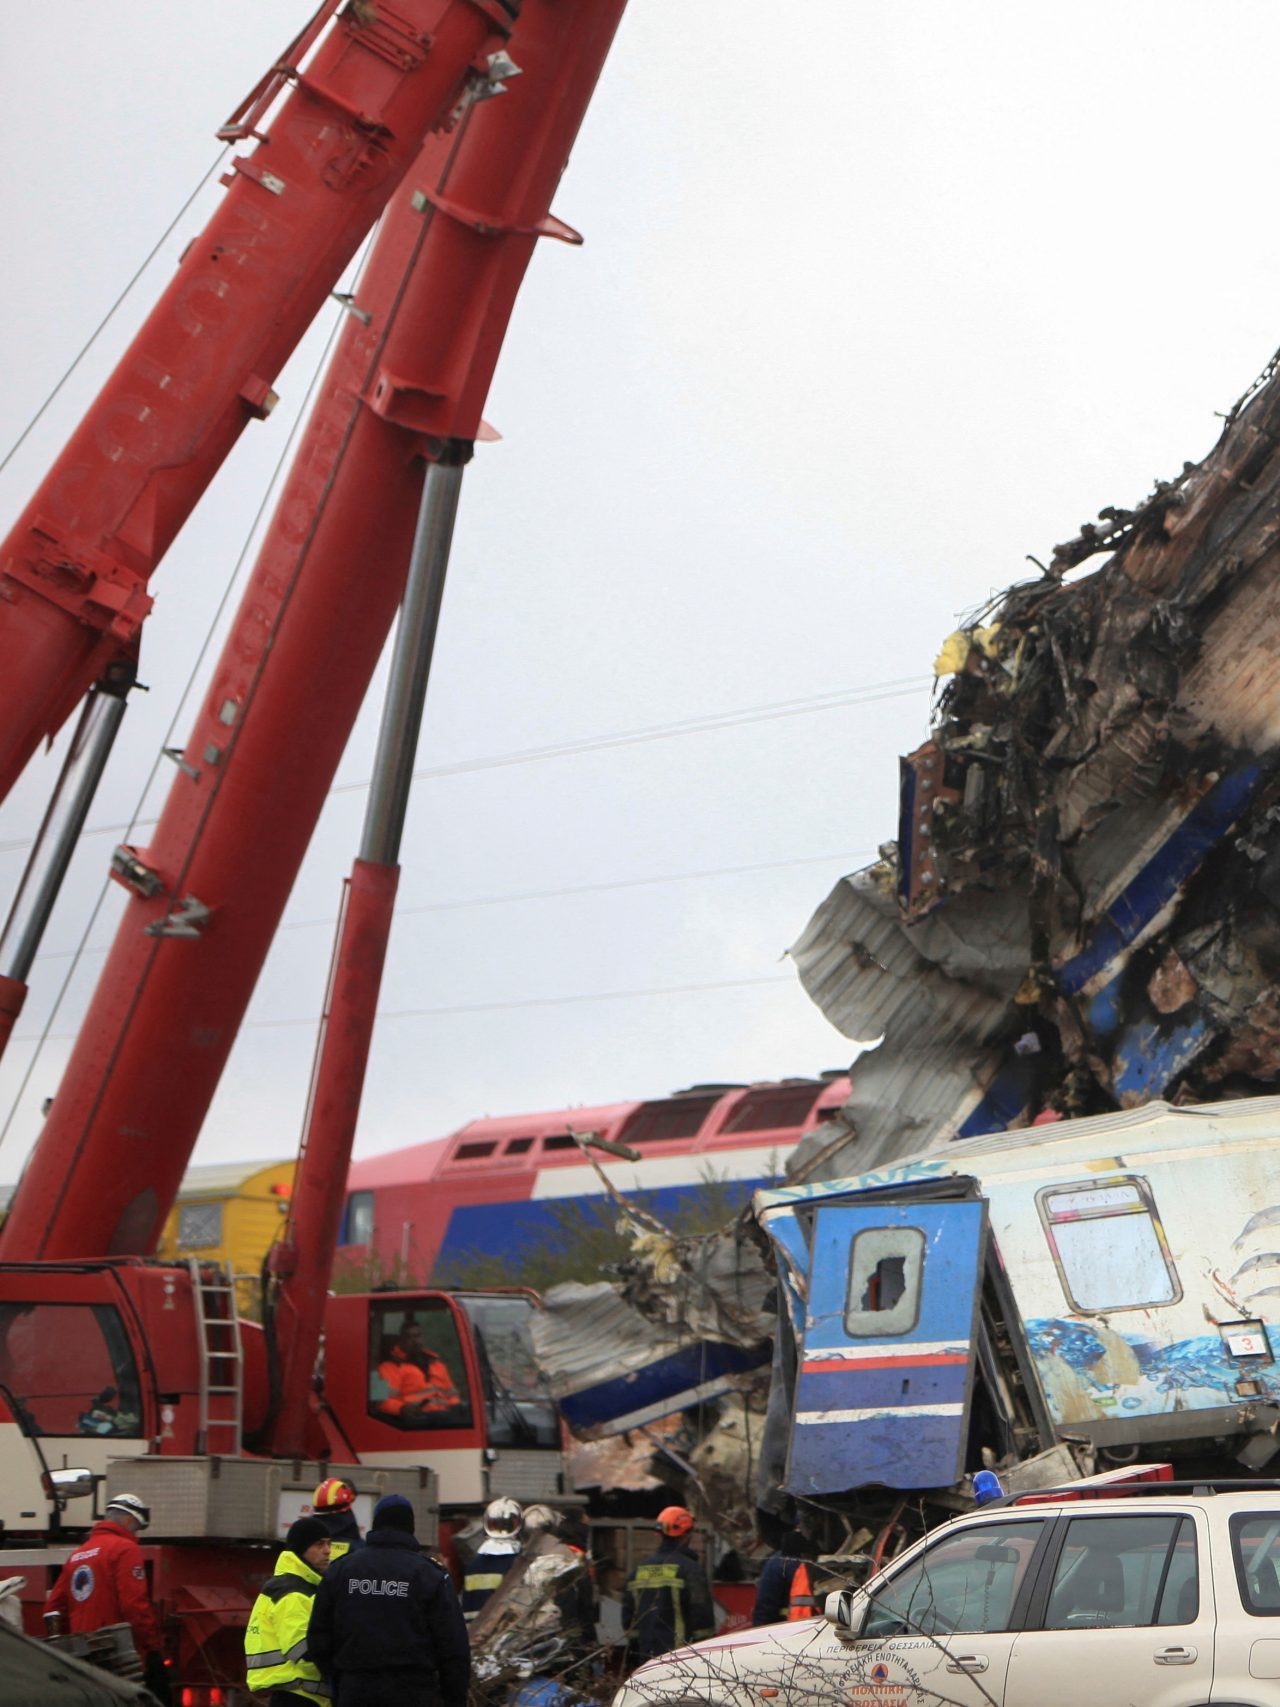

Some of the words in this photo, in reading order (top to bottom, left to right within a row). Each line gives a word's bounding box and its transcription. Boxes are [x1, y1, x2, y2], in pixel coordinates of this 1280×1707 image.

[1241, 1337, 1254, 1351] 3
[348, 1579, 409, 1597] POLICE
[826, 1643, 883, 1654] ΠΕΡΙΦΕΡΕΙΑ
[852, 1685, 904, 1695] ΠΟΛΙΤΙΚΗ
